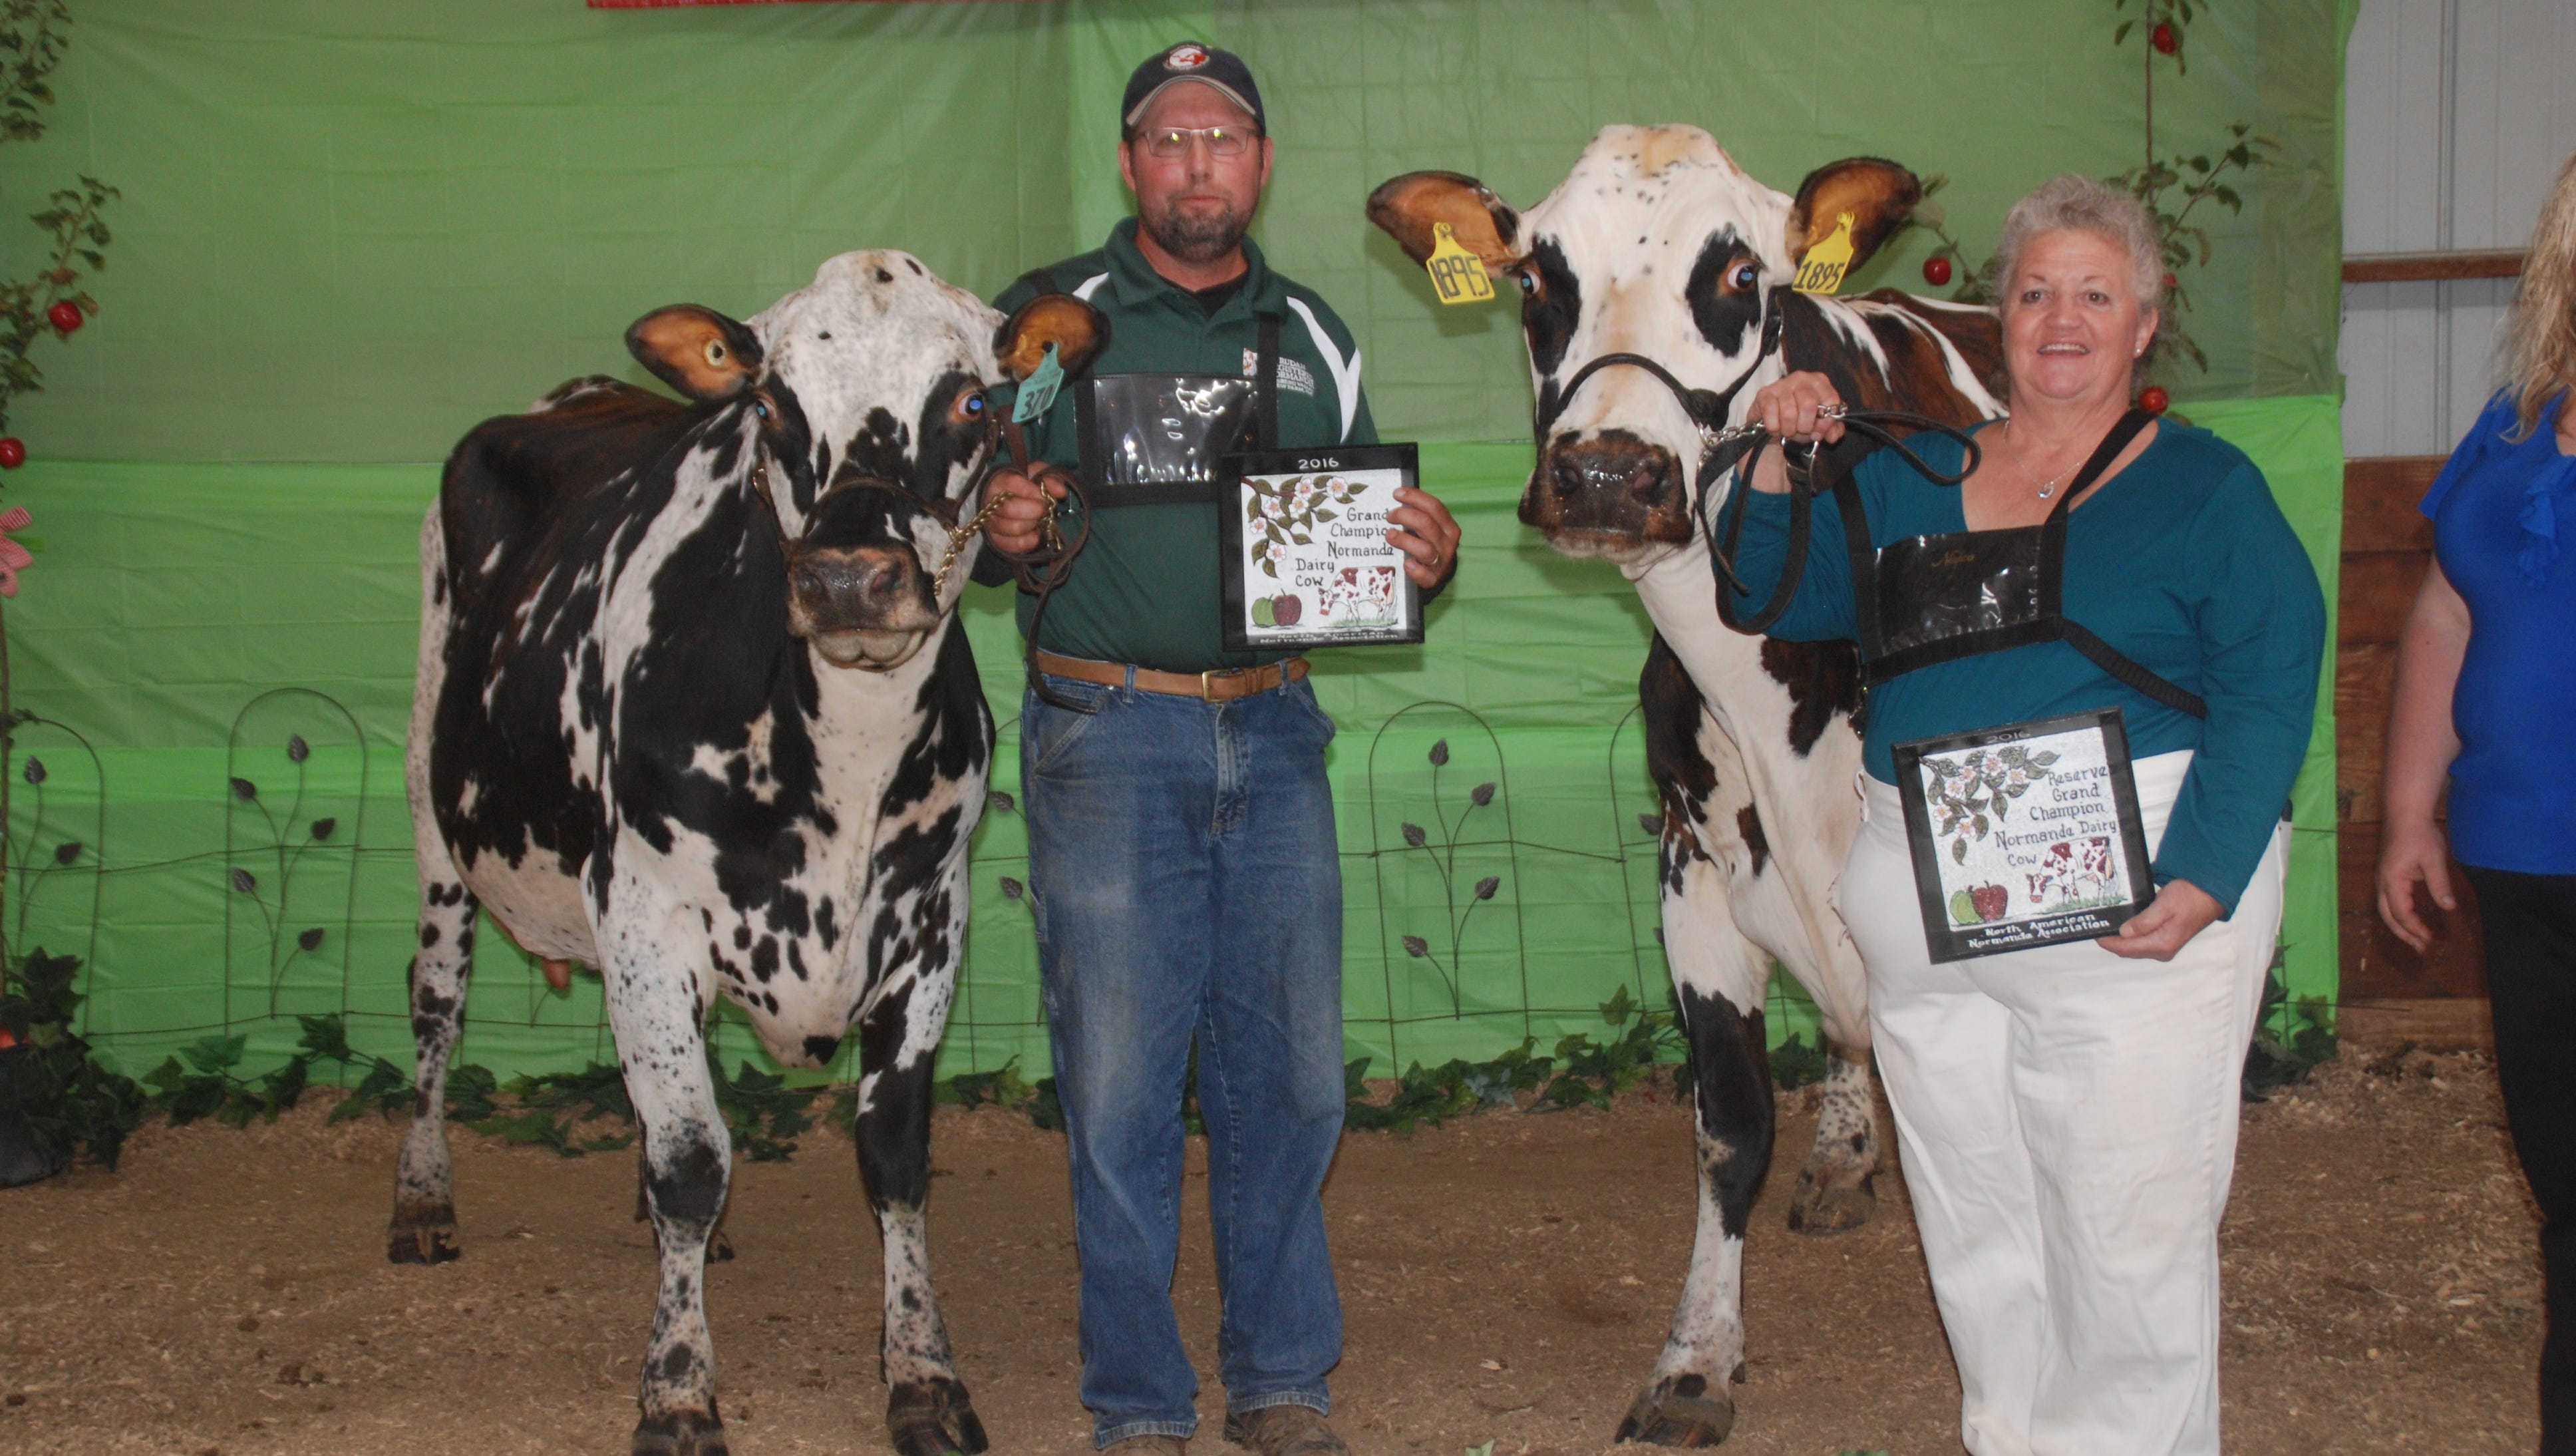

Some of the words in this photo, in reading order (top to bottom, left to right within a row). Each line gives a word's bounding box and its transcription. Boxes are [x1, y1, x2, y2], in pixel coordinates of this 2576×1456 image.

[1430, 256, 1490, 299] 1895
[1793, 260, 1845, 290] 1895
[1298, 458, 1339, 470] 2016
[1331, 523, 1394, 539] Champio
[1327, 540, 1394, 559] Normande
[1295, 558, 1335, 573] Dairy
[1295, 575, 1324, 587] Cow
[1986, 731, 2030, 744] 2016
[2048, 765, 2108, 786] Reserve
[2053, 783, 2100, 802] Grand
[1995, 826, 2074, 849] Normande
[2080, 819, 2117, 834] Dairy
[2008, 854, 2038, 866] Cow
[1967, 932, 2032, 948] Normande
[2037, 919, 2110, 938] Association
[1985, 925, 2021, 936] North
[2029, 914, 2096, 930] American
